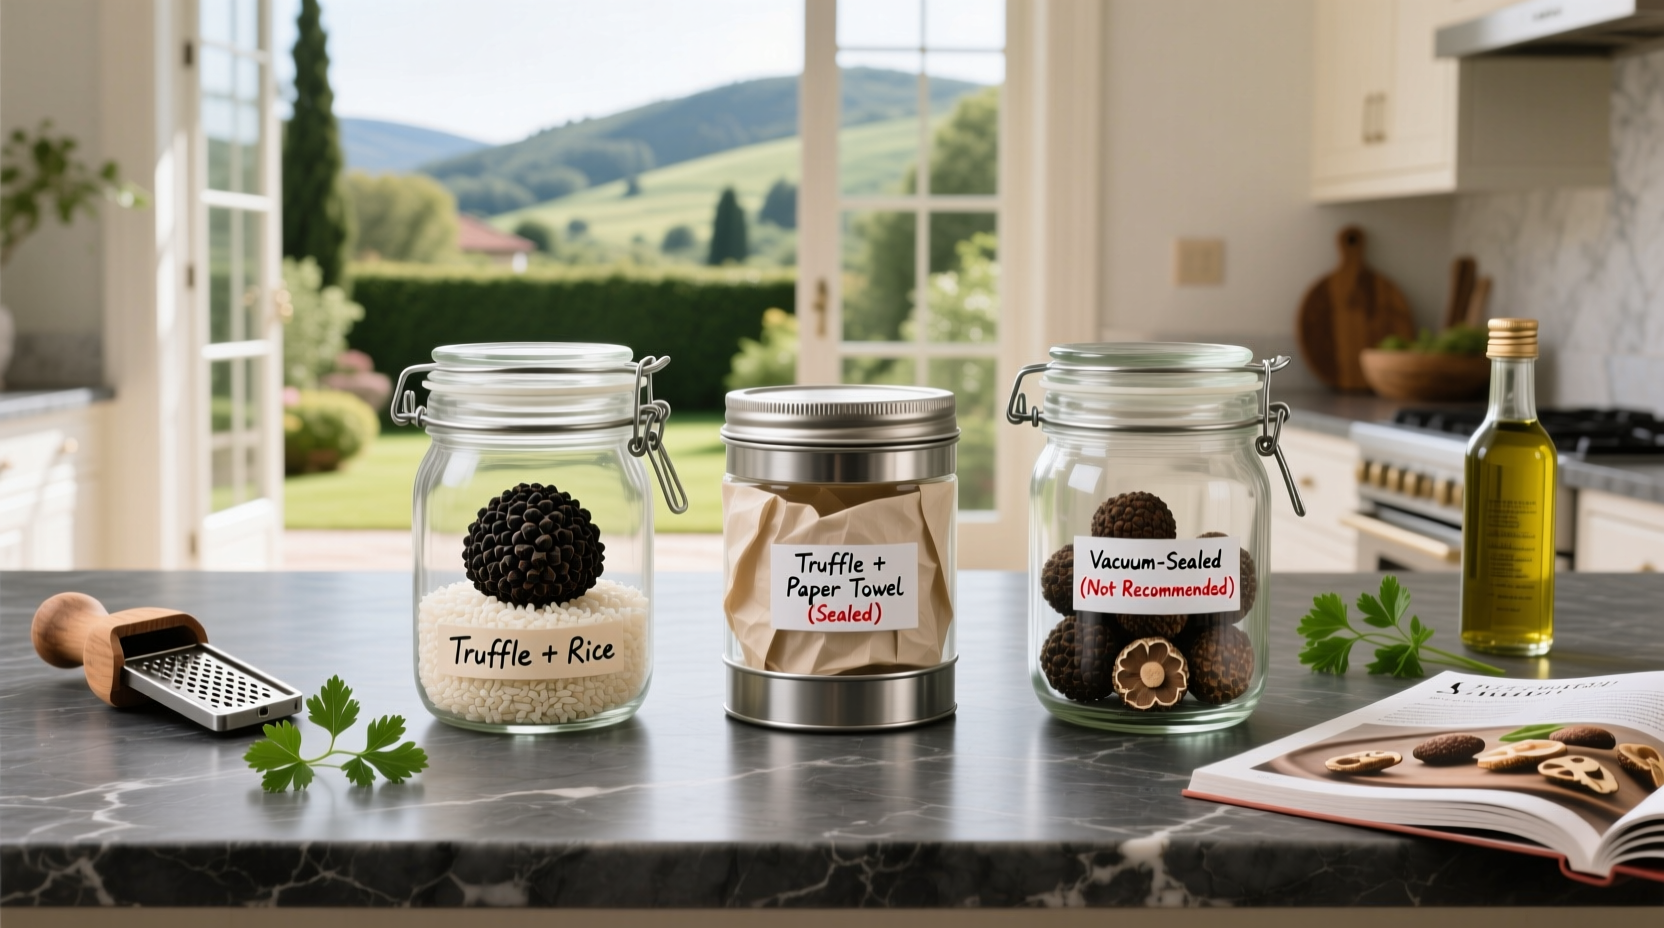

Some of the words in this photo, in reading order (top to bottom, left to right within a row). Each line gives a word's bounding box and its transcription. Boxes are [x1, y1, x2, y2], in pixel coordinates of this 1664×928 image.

[795, 552, 864, 576] Truffle
[873, 556, 886, 571] +
[1090, 548, 1222, 570] Vacuum-Sealed
[787, 576, 841, 605] Paper
[849, 576, 904, 598] Towel
[1080, 576, 1117, 599] (Not
[1122, 576, 1235, 599] Recommended)
[808, 602, 882, 625] (Sealed)
[449, 635, 532, 669] Truffle
[542, 645, 558, 663] +
[567, 636, 616, 664] Rice
